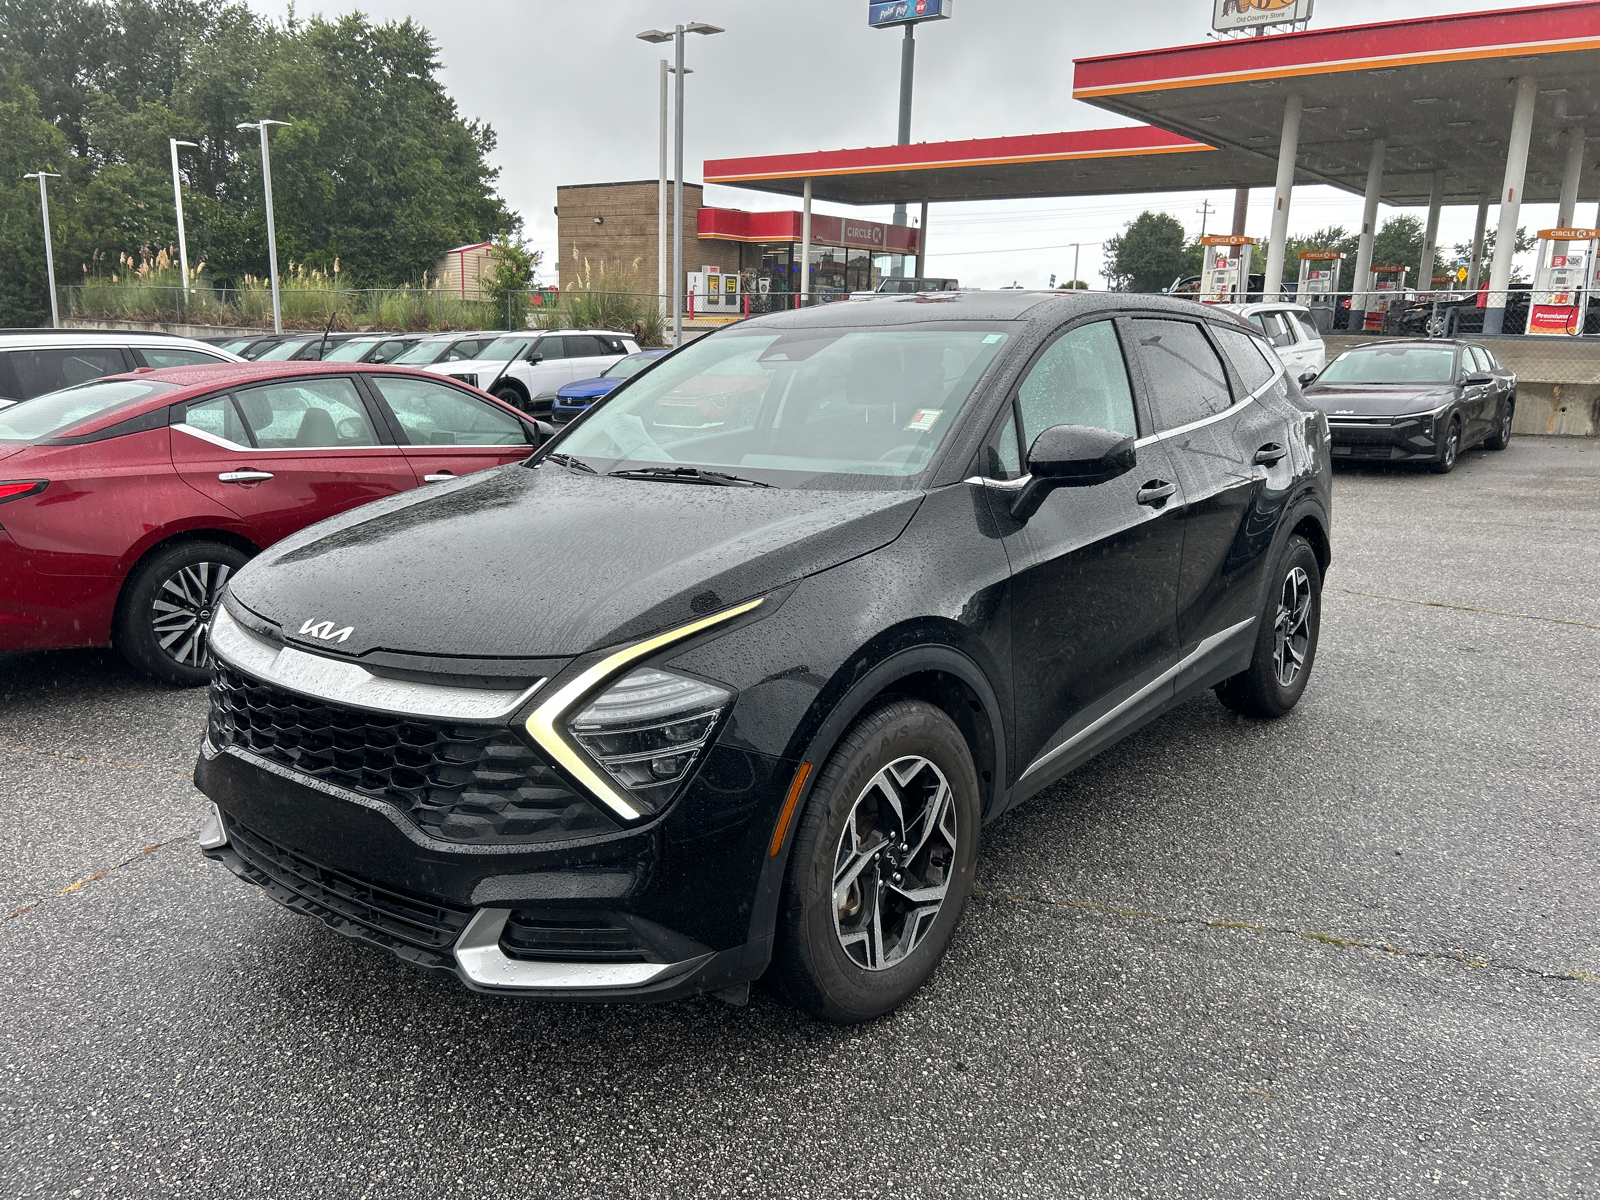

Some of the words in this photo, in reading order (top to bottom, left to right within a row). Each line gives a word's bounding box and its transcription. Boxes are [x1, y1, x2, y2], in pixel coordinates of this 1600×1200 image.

[880, 6, 896, 20] Polar
[895, 5, 908, 17] Pop
[1246, 14, 1269, 22] Country
[847, 226, 872, 239] CIRCLE
[872, 226, 882, 243] K
[1576, 230, 1586, 238] K
[298, 617, 355, 644] KIA
[879, 724, 910, 753] A/S
